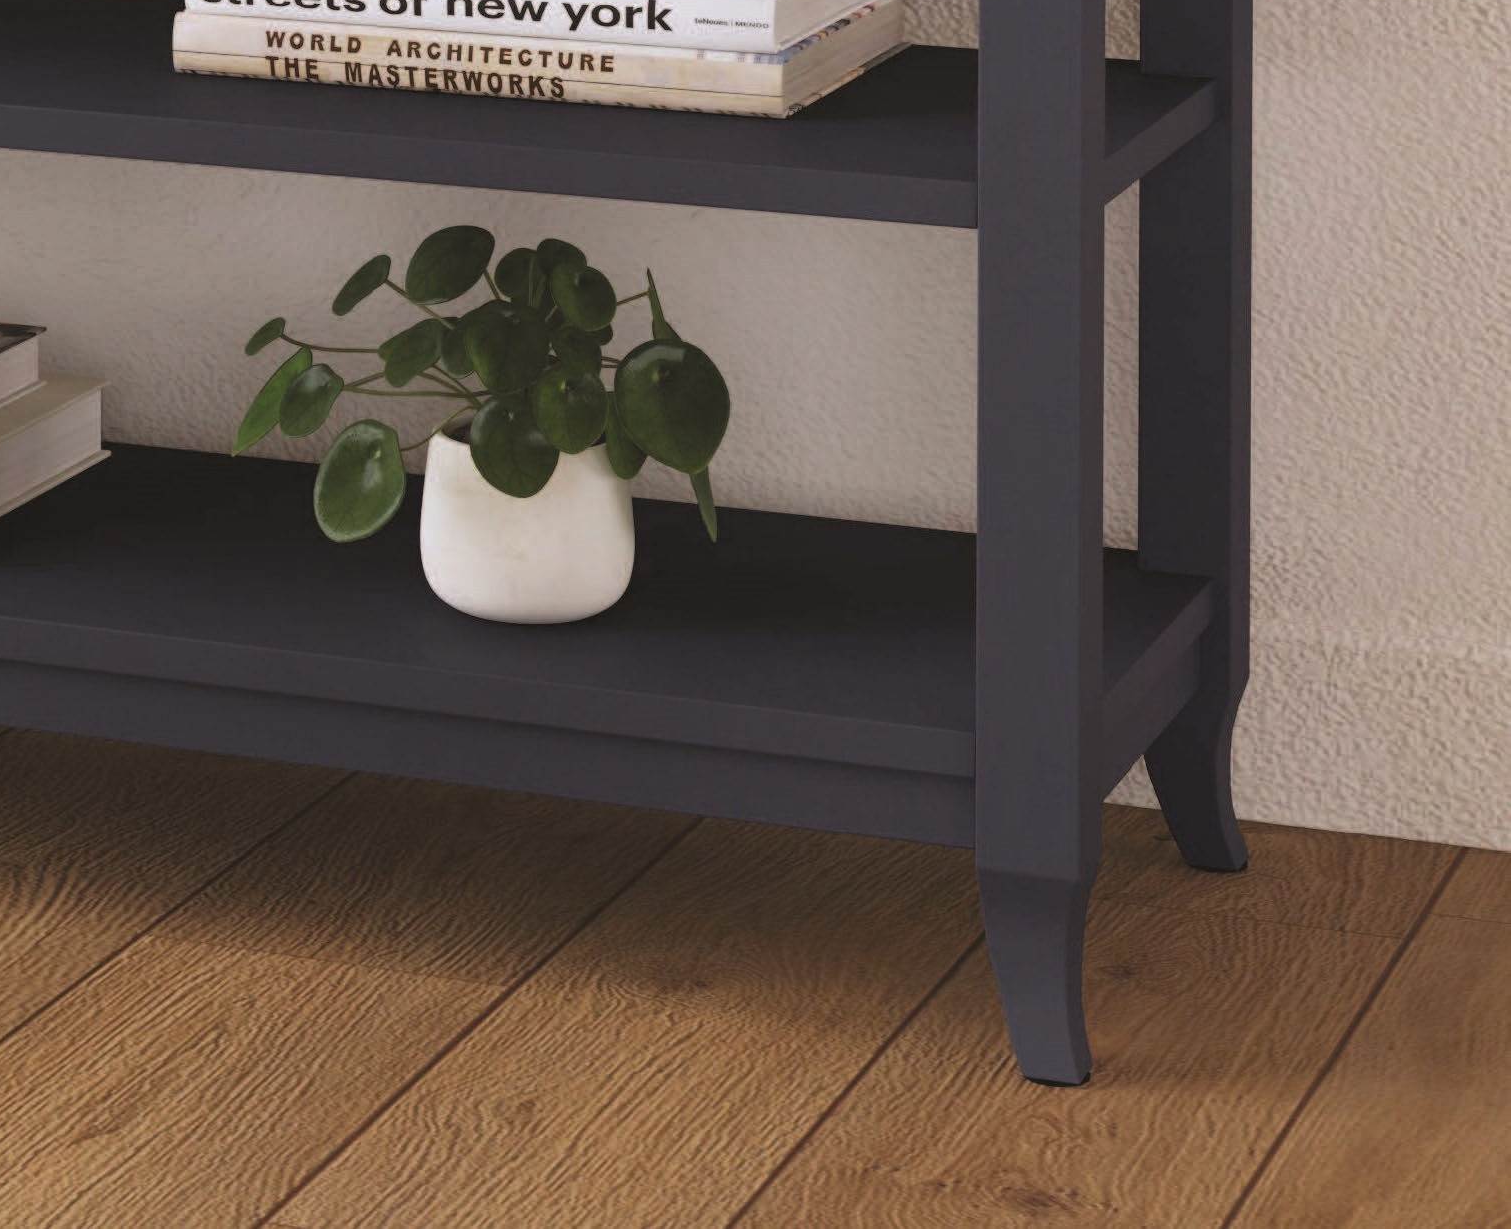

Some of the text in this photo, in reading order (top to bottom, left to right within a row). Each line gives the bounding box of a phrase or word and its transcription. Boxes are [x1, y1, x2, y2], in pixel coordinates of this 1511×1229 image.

[265, 30, 615, 73] WORLD ARCHITECTURE
[265, 55, 566, 99] THE MASTERWORKS
